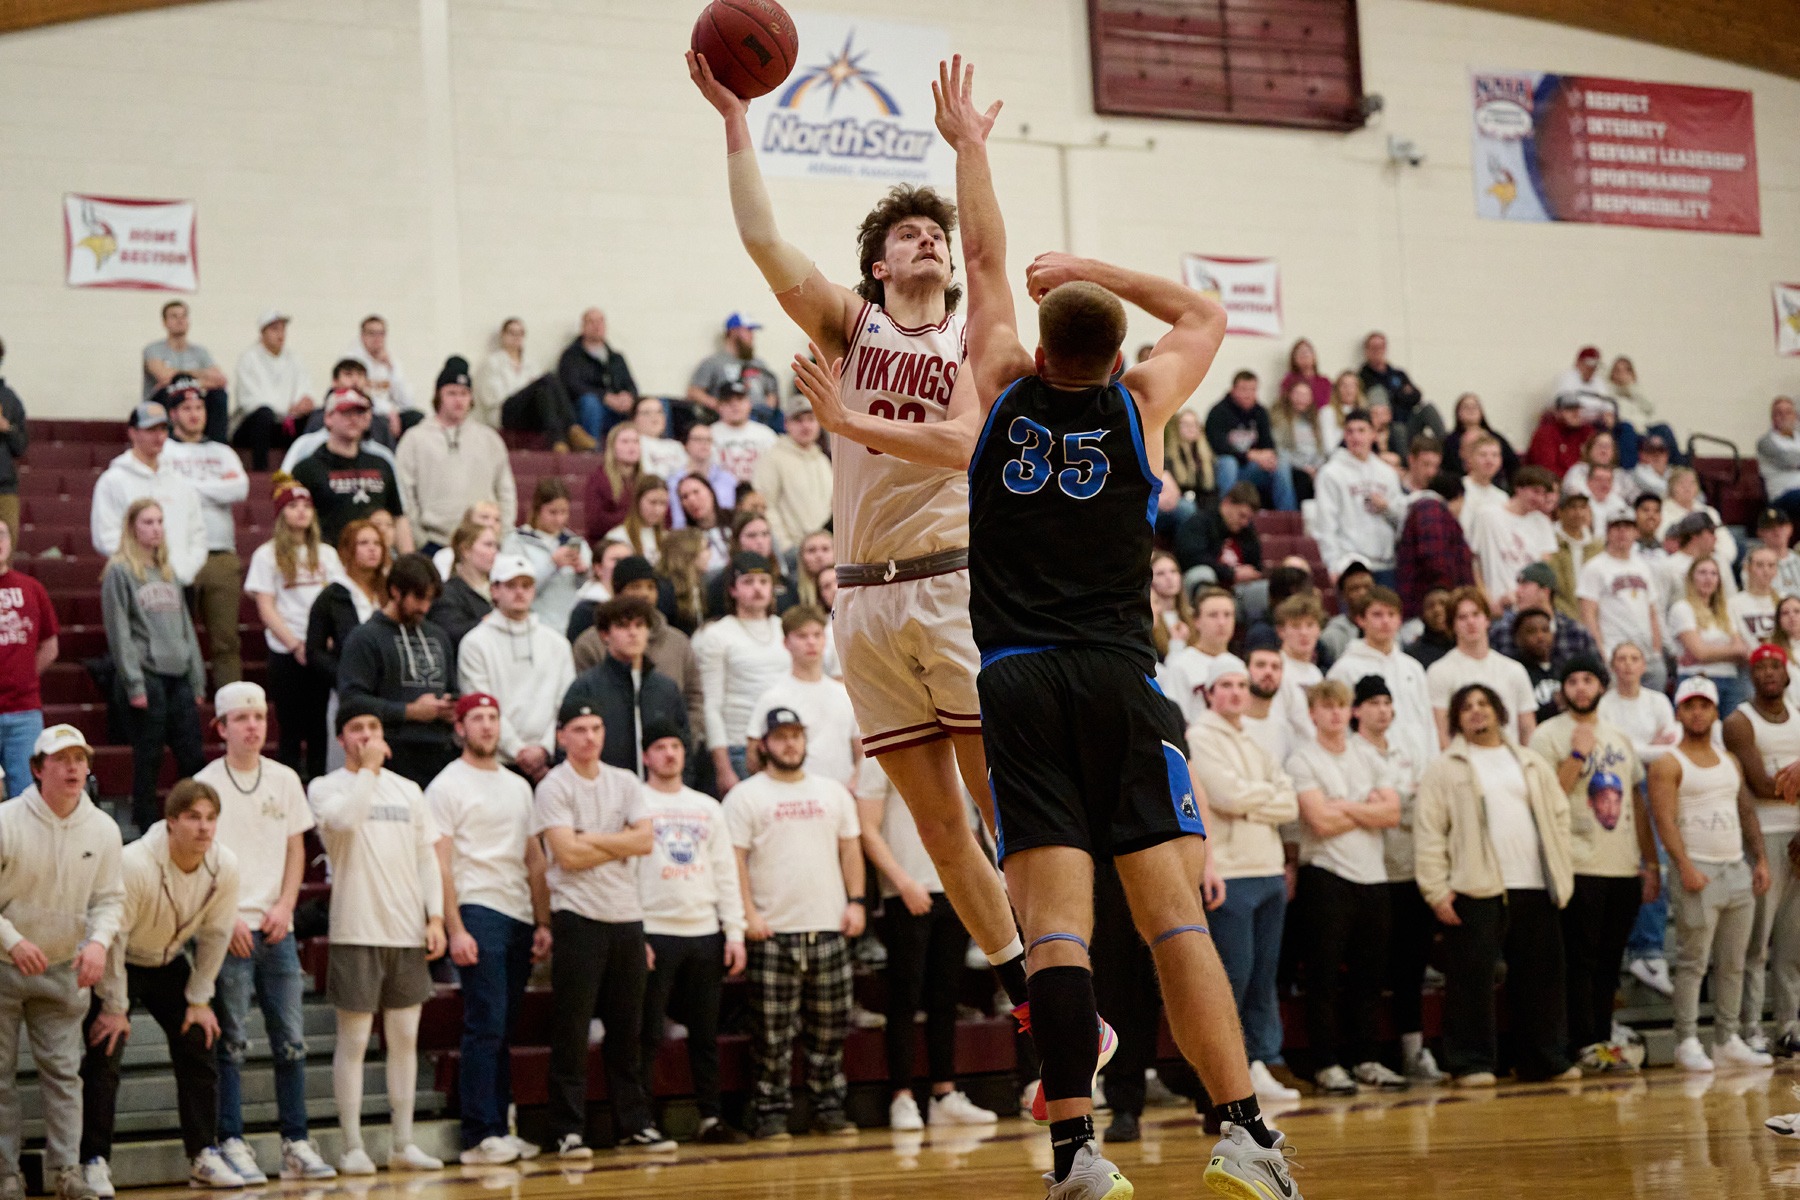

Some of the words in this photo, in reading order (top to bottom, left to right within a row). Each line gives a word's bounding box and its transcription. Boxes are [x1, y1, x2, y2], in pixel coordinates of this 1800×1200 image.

[1585, 90, 1649, 113] RESPECT
[762, 113, 933, 162] NorthStar
[1586, 116, 1667, 139] INTEGRITY
[1588, 142, 1657, 164] SERVANT
[1660, 147, 1746, 171] LEADERSHIP
[1590, 167, 1712, 194] SPORTSMANSHIP
[1591, 194, 1711, 219] RESPONSIBILITY
[129, 229, 176, 242] HOME
[120, 249, 187, 264] SECTION
[855, 345, 957, 406] VIKINGS
[1003, 416, 1112, 500] 35
